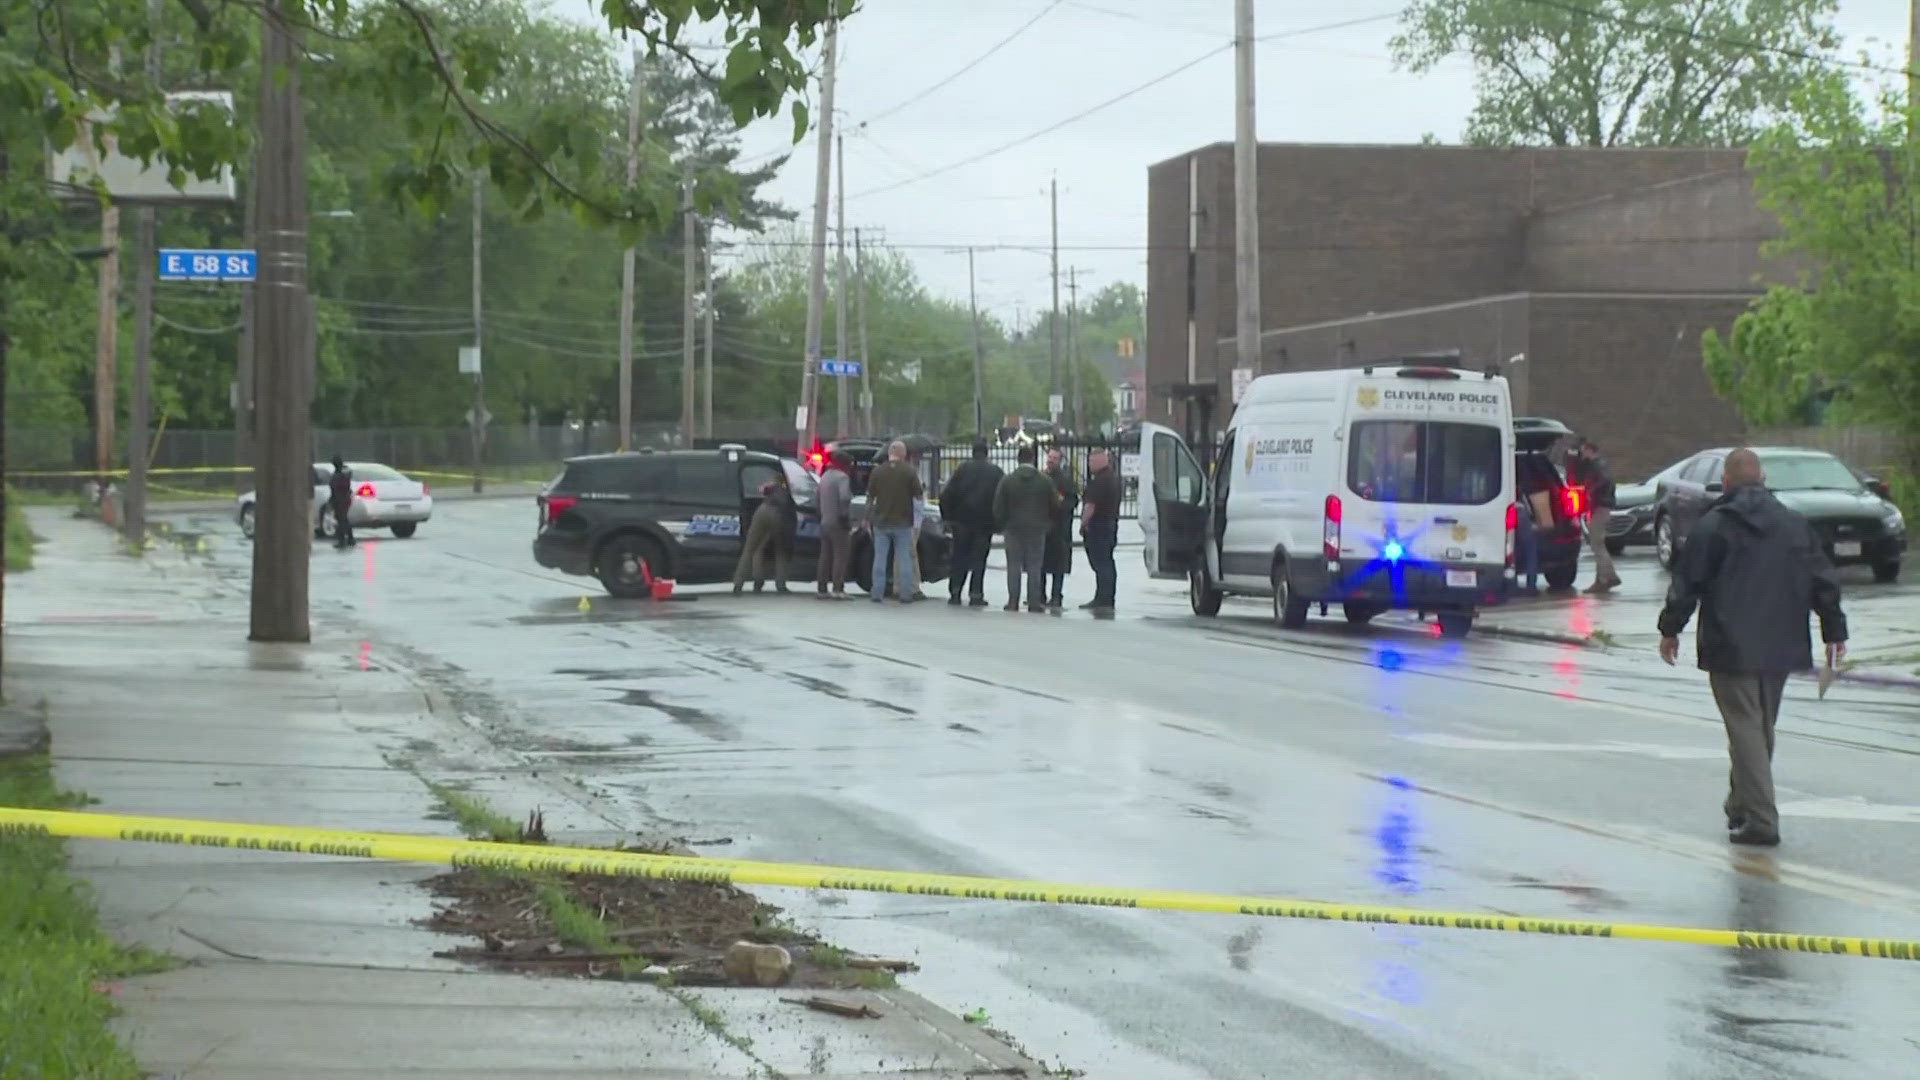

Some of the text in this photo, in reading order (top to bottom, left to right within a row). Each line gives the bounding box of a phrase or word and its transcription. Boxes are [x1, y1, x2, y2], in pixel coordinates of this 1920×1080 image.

[167, 254, 250, 274] E. 58 St
[1384, 389, 1498, 404] CLEVELAND POLICE
[1290, 438, 1313, 454] POLICE
